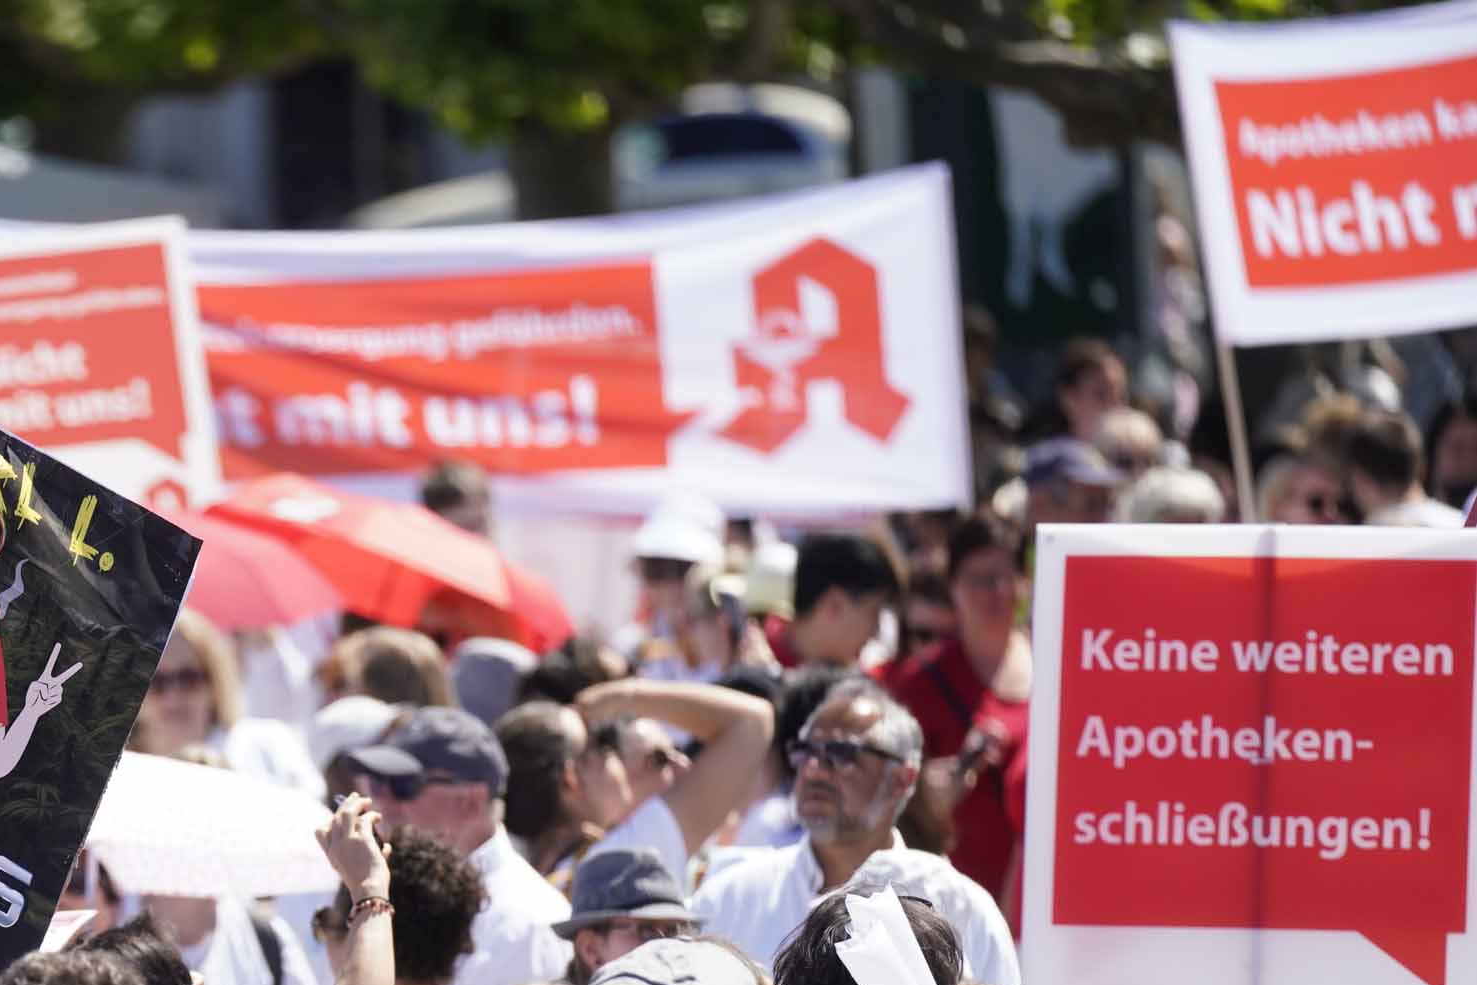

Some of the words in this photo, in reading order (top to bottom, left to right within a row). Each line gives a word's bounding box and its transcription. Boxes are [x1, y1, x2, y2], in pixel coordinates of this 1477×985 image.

[1246, 180, 1442, 260] Nicht
[425, 374, 601, 449] uns!
[1081, 628, 1220, 672] Keine
[1232, 630, 1455, 676] weiteren
[1076, 714, 1375, 768] Apotheken-
[1073, 800, 1432, 860] schließungen!
